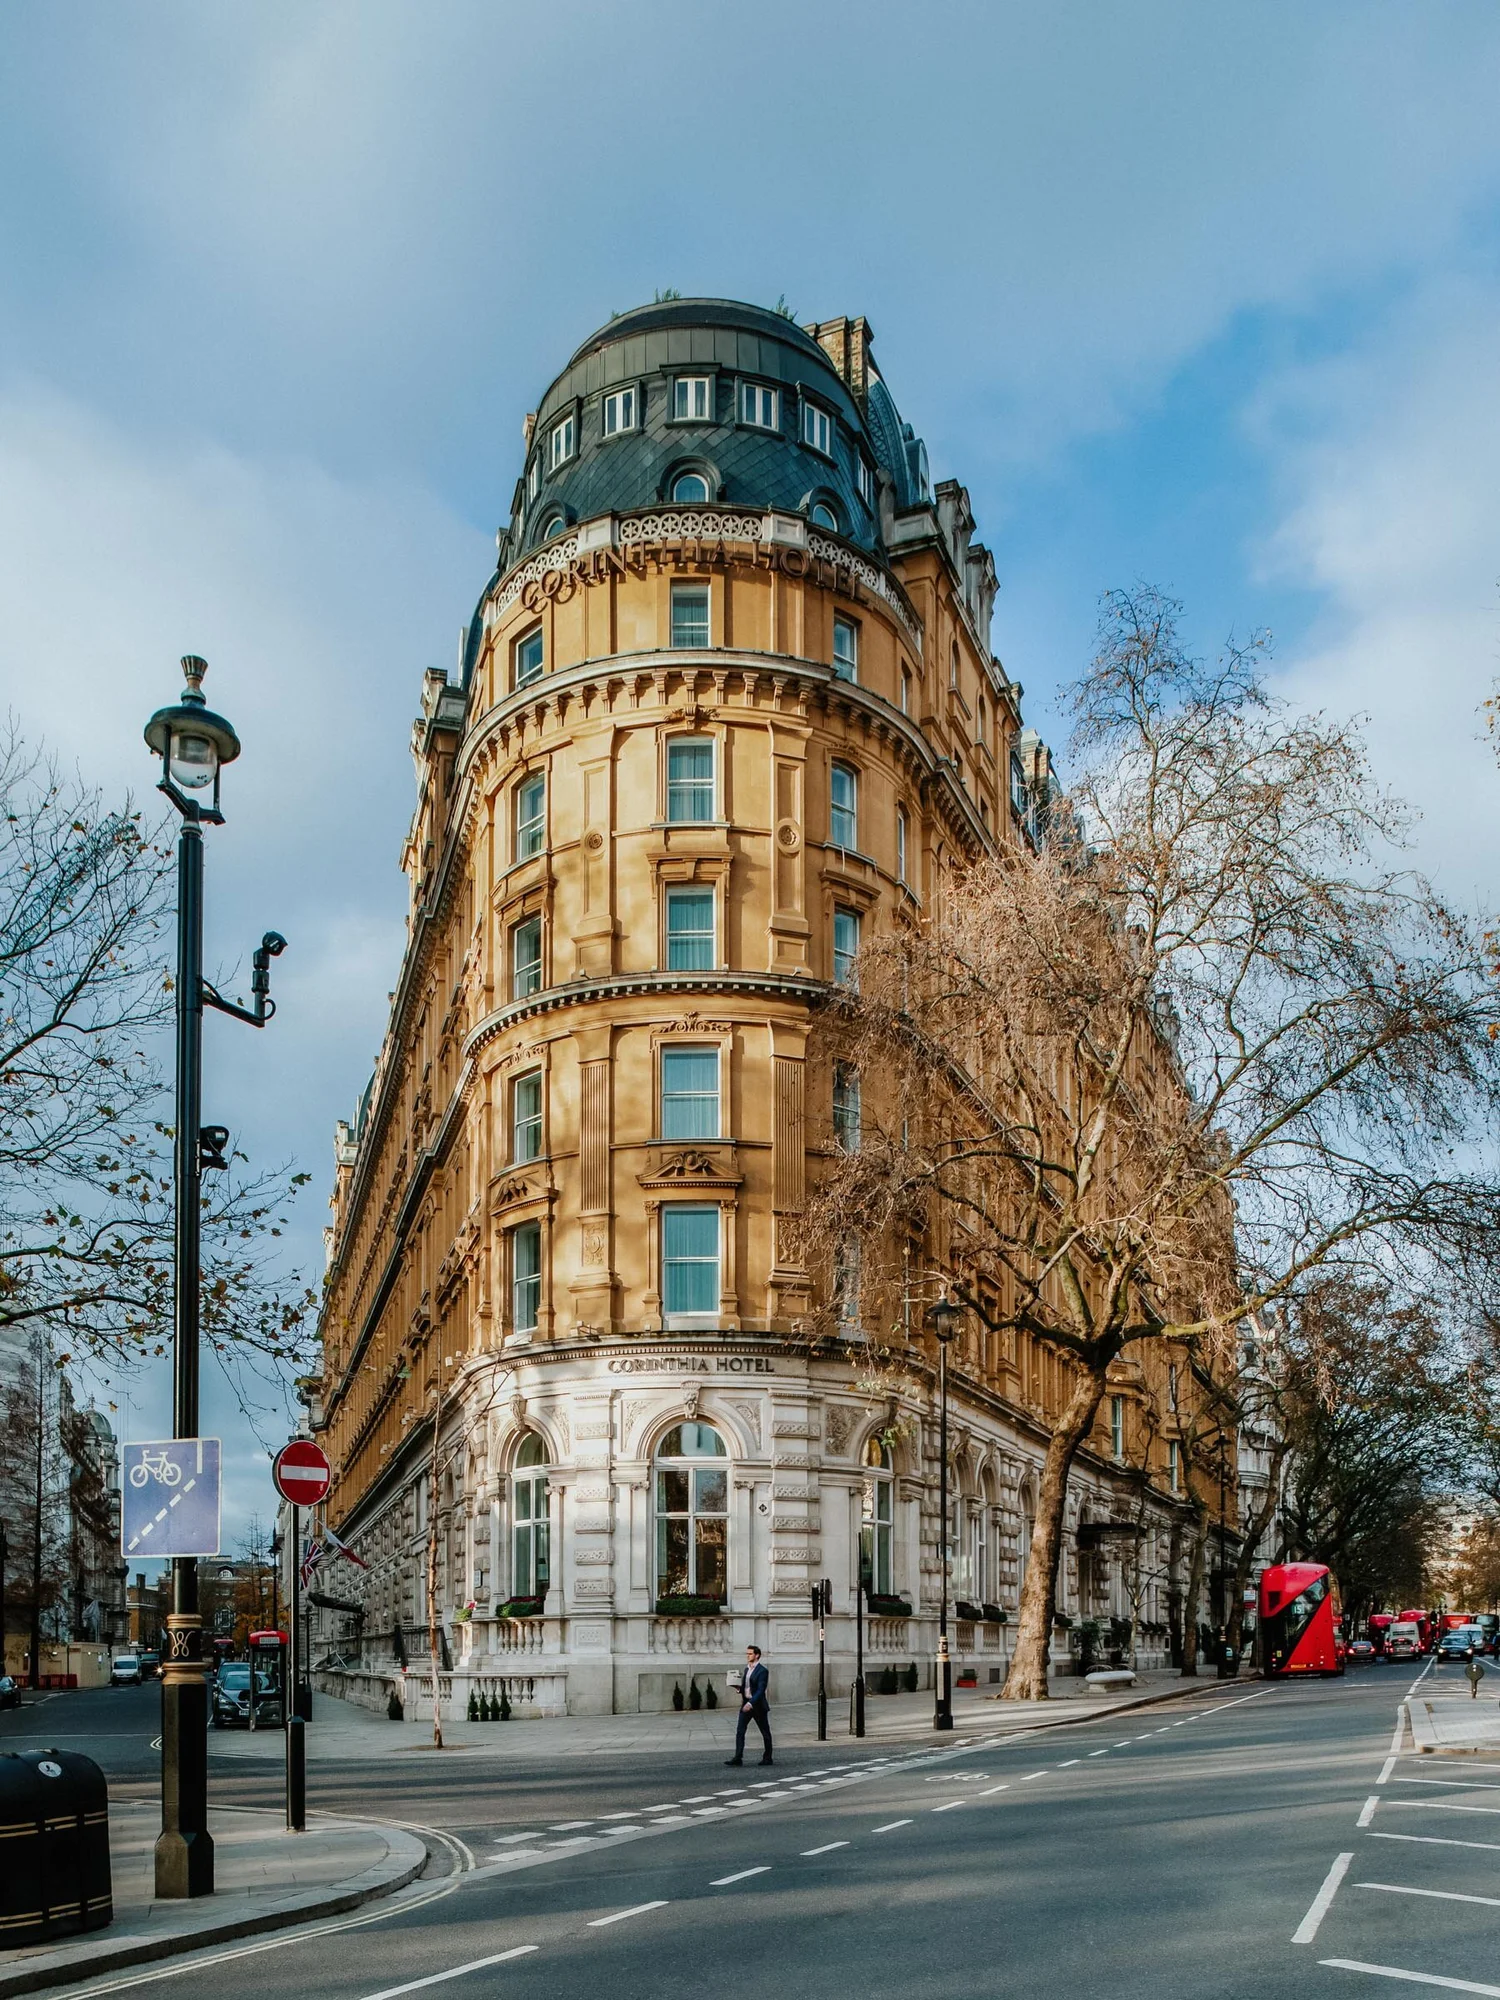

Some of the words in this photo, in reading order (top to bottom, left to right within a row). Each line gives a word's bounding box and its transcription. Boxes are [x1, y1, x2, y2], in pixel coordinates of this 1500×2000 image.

[521, 536, 734, 610] CORINTHIA
[752, 539, 869, 605] HOTEL
[608, 1357, 709, 1373] CORINTHIA
[716, 1357, 774, 1373] HOTEL
